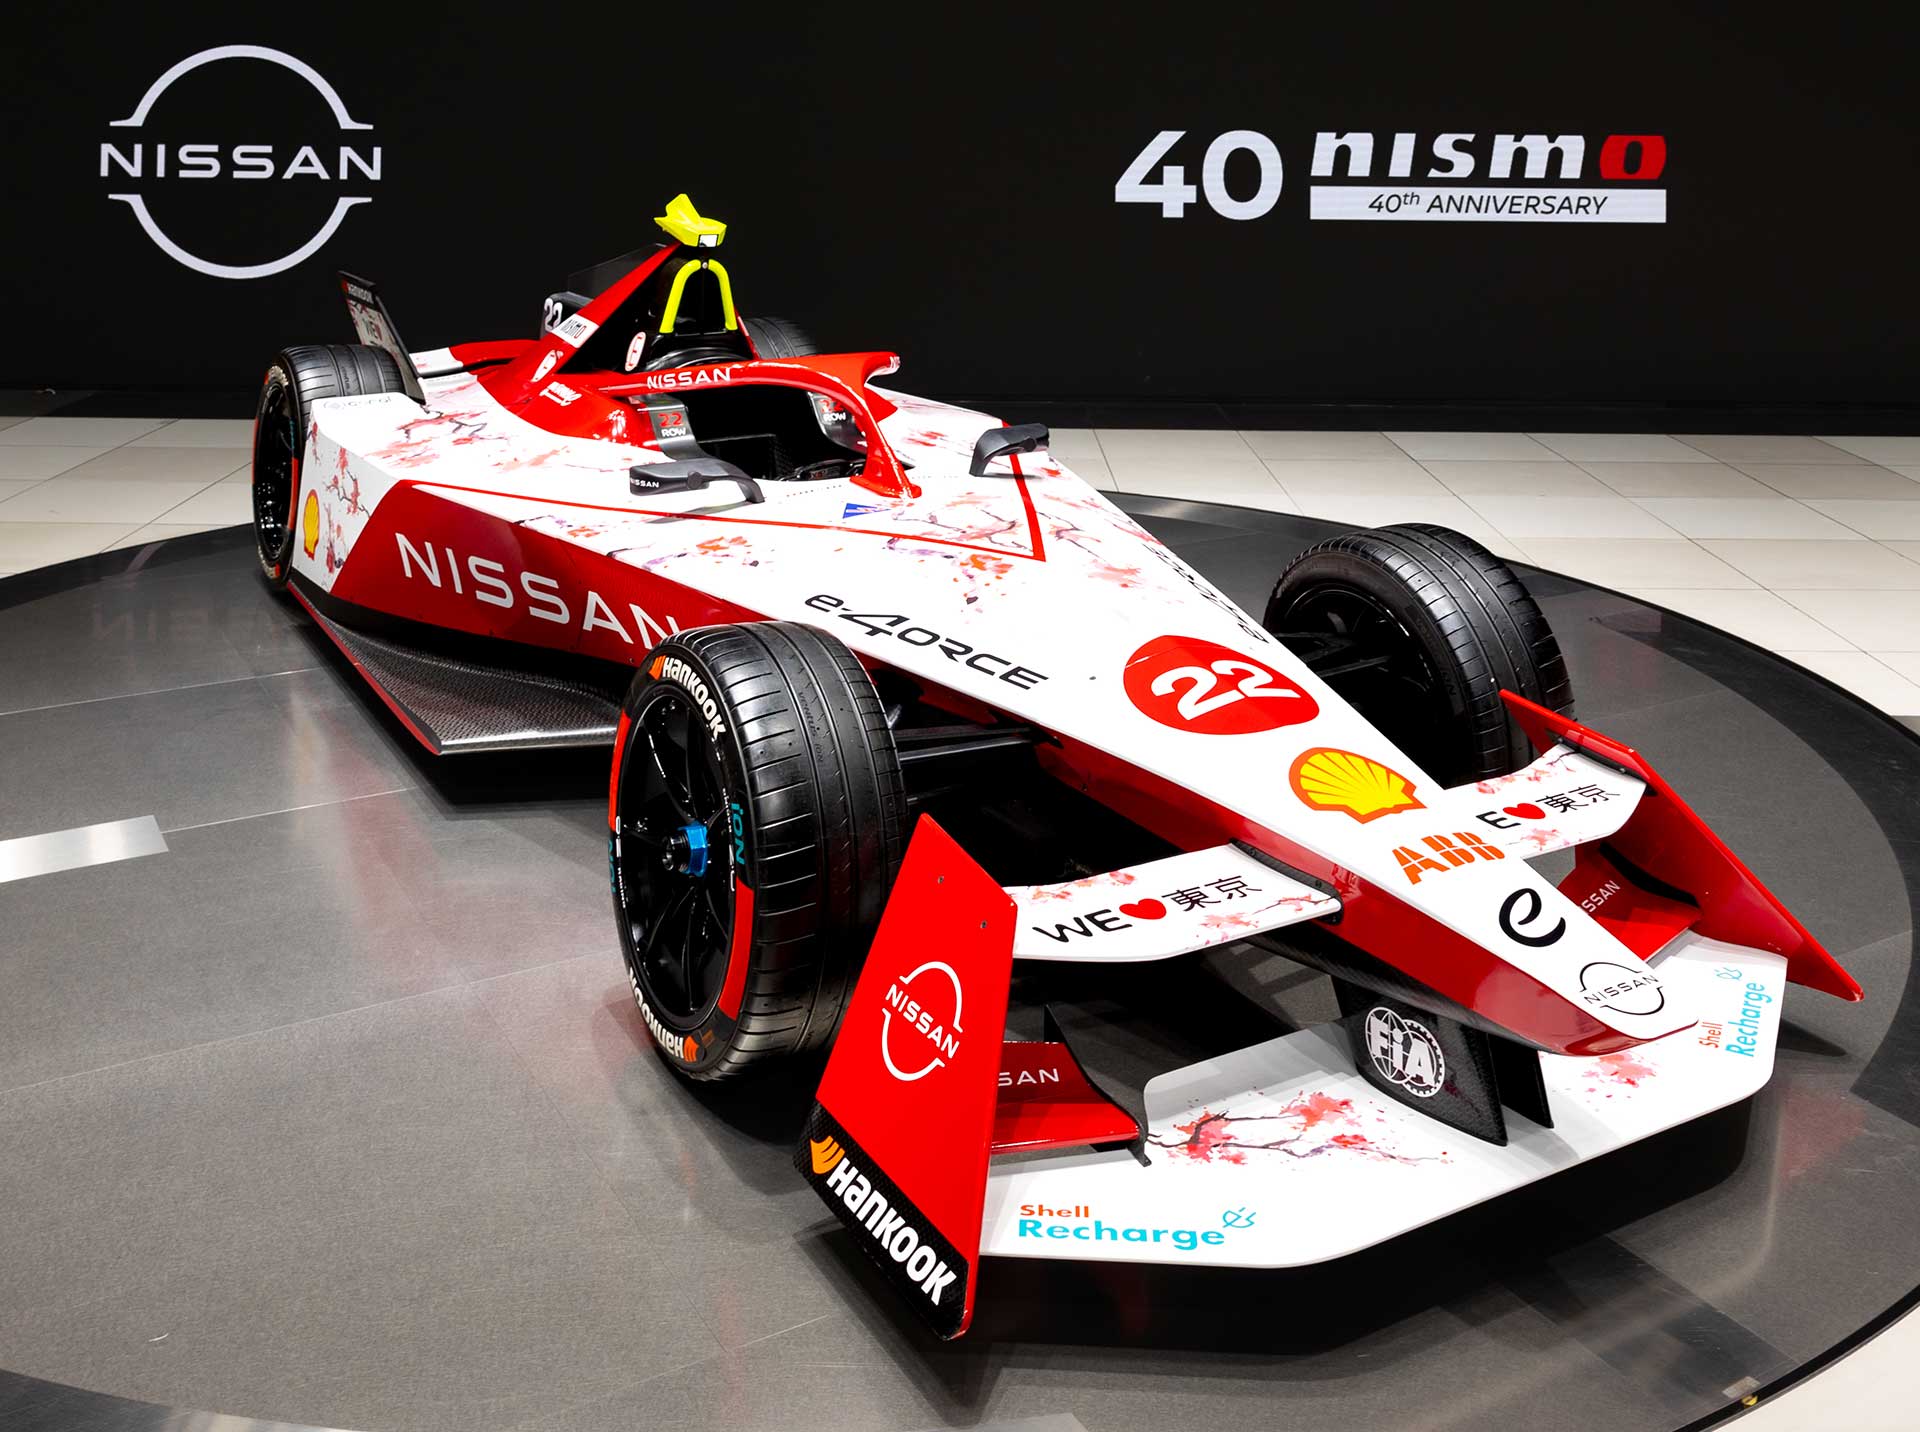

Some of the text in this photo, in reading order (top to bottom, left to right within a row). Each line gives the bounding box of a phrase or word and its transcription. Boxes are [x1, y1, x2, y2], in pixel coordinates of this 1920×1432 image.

[101, 143, 381, 180] NISSAN
[1114, 129, 1284, 221] 40
[1368, 191, 1609, 215] 40th ANNIVERSARY
[646, 367, 732, 389] NISSAN
[658, 411, 684, 428] 22
[661, 427, 687, 438] ROW
[395, 532, 681, 650] NISSAN
[1151, 659, 1302, 721] 22
[1534, 784, 1621, 814] 東京
[1392, 832, 1505, 885] ABB
[1032, 875, 1262, 943] WE 東京
[1581, 880, 1621, 912] SSAN
[1584, 974, 1659, 1005] NISSAN
[885, 983, 960, 1059] NISSAN
[1699, 1022, 1723, 1049] Shell
[1725, 982, 1773, 1058] Recharge
[997, 1068, 1060, 1087] SAN
[1020, 1204, 1090, 1218] Shell
[1018, 1219, 1225, 1251] Recharge
